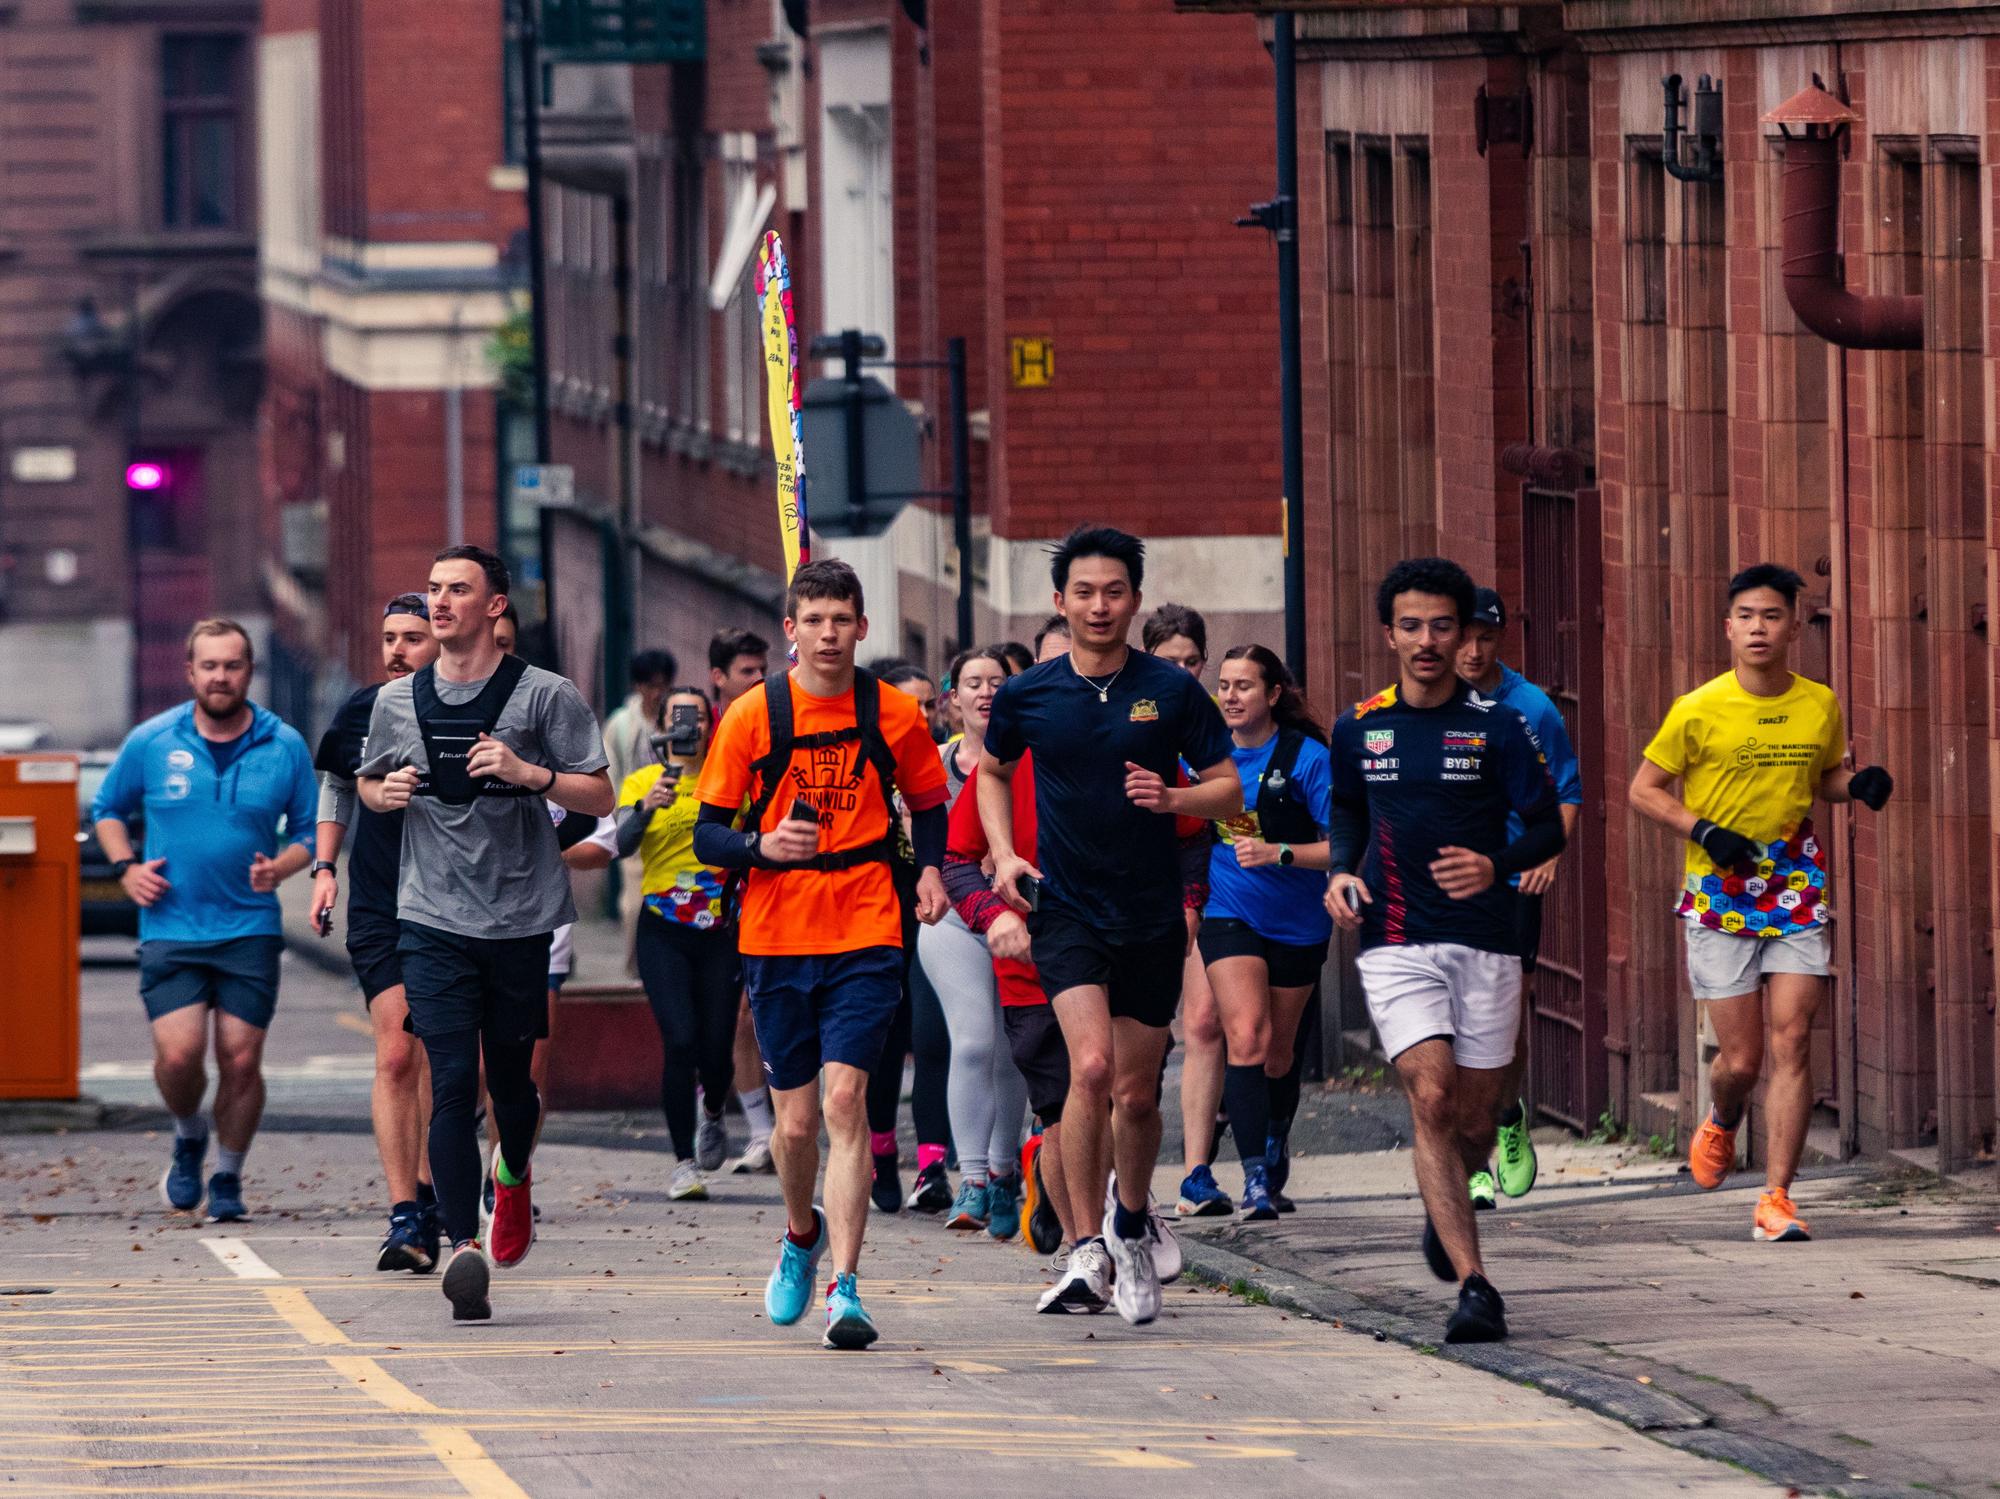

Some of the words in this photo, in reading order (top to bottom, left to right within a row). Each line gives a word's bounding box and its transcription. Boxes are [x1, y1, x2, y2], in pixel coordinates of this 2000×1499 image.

[1019, 344, 1049, 379] H
[1369, 732, 1391, 741] TAG
[1445, 757, 1482, 769] BYBIT
[1365, 773, 1399, 781] ORACLE
[1442, 773, 1482, 781] HONDA
[1750, 882, 1763, 891] 24
[1783, 894, 1796, 904] 24
[1727, 917, 1740, 926] 24
